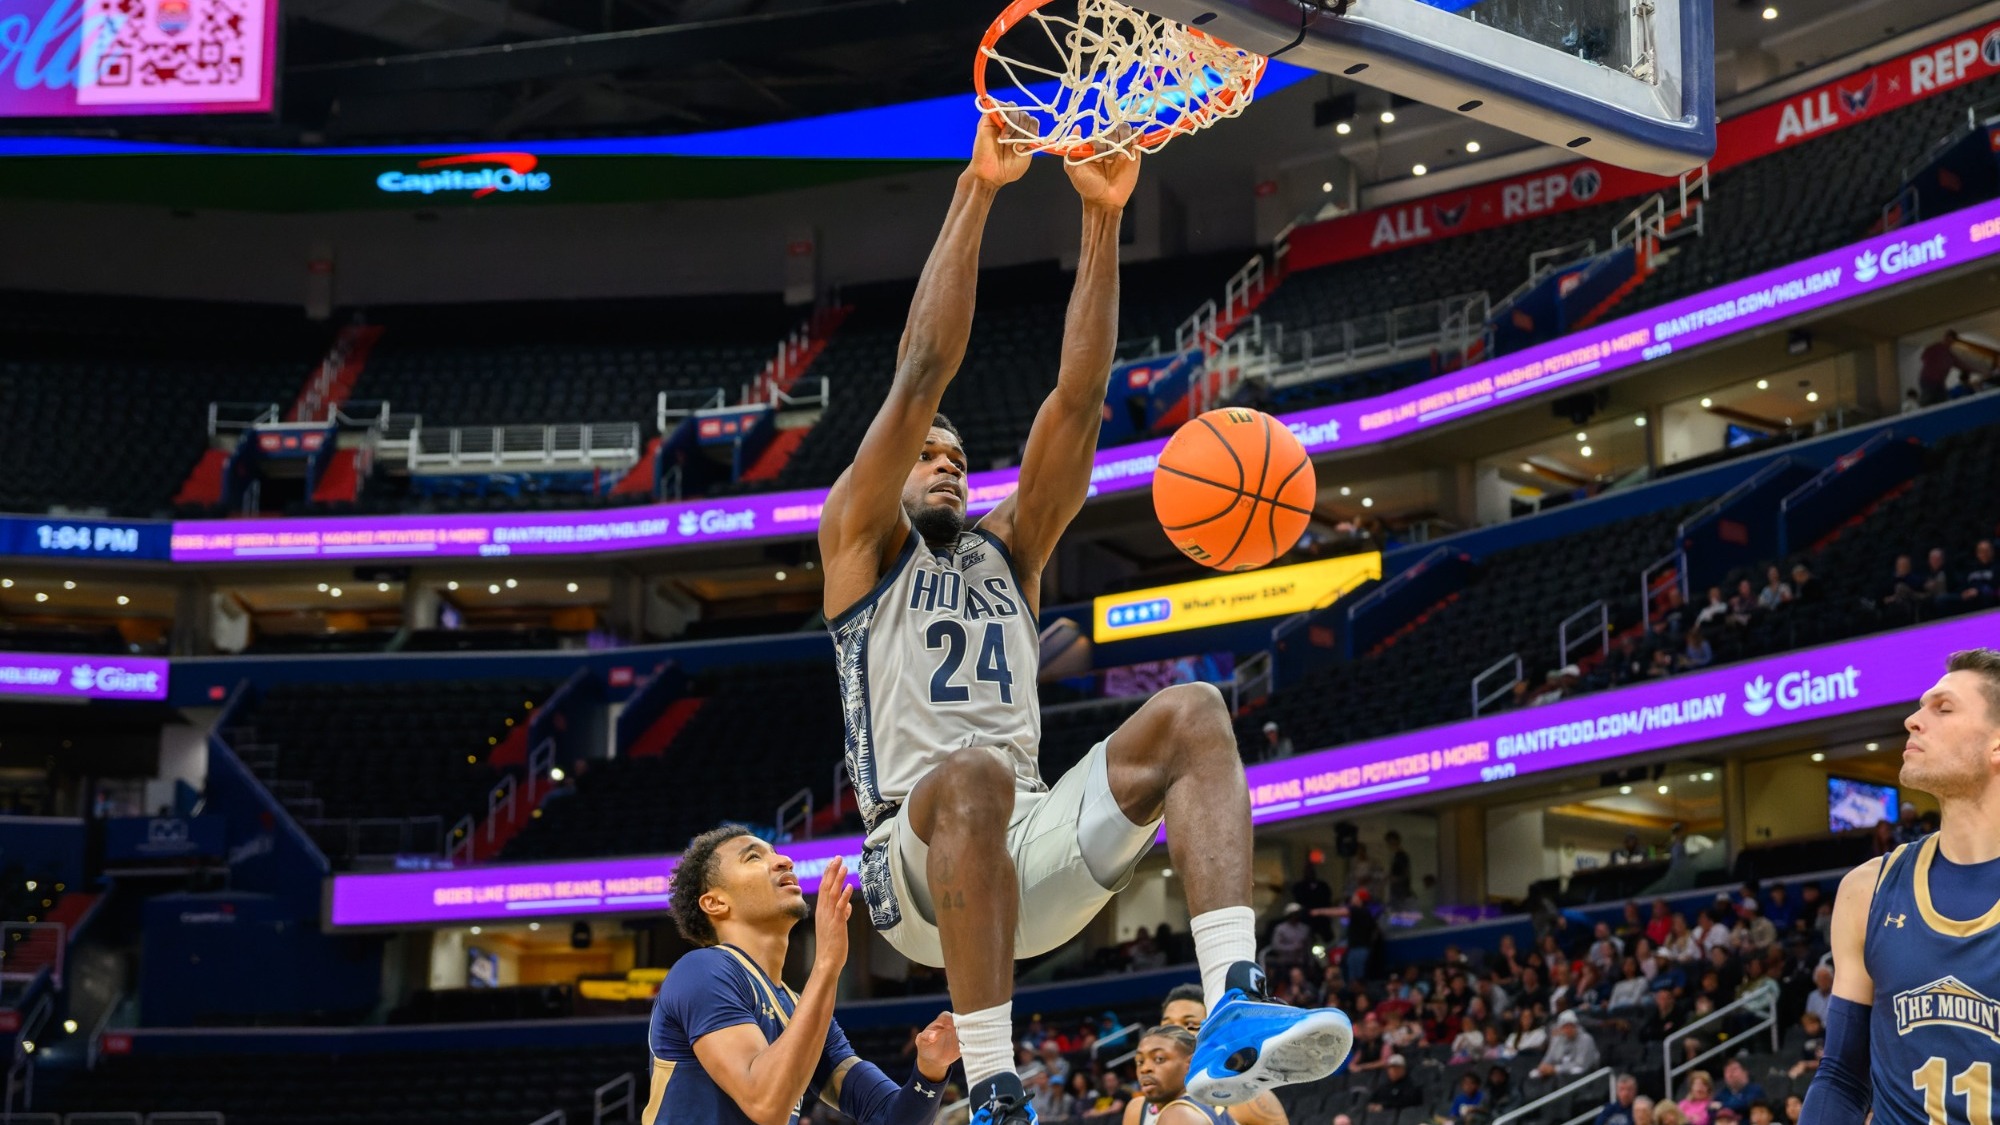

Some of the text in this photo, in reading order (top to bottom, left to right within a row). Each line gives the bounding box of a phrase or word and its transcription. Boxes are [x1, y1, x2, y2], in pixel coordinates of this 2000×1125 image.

[1776, 38, 1980, 144] ALL REP
[1371, 175, 1568, 248] ALL REP
[1880, 233, 1947, 275] Giant
[37, 525, 138, 551] 1:04 PM
[700, 509, 756, 535] Giant
[962, 551, 978, 561] BIG
[908, 568, 1018, 622] HOAS
[96, 666, 159, 692] Giant
[925, 619, 1013, 706] 24
[1496, 693, 1727, 759] GIANTFOOD.COM/HOLIDAY
[1776, 665, 1858, 710] Giant
[1898, 995, 1933, 1026] THE
[1912, 1056, 1992, 1125] 11
